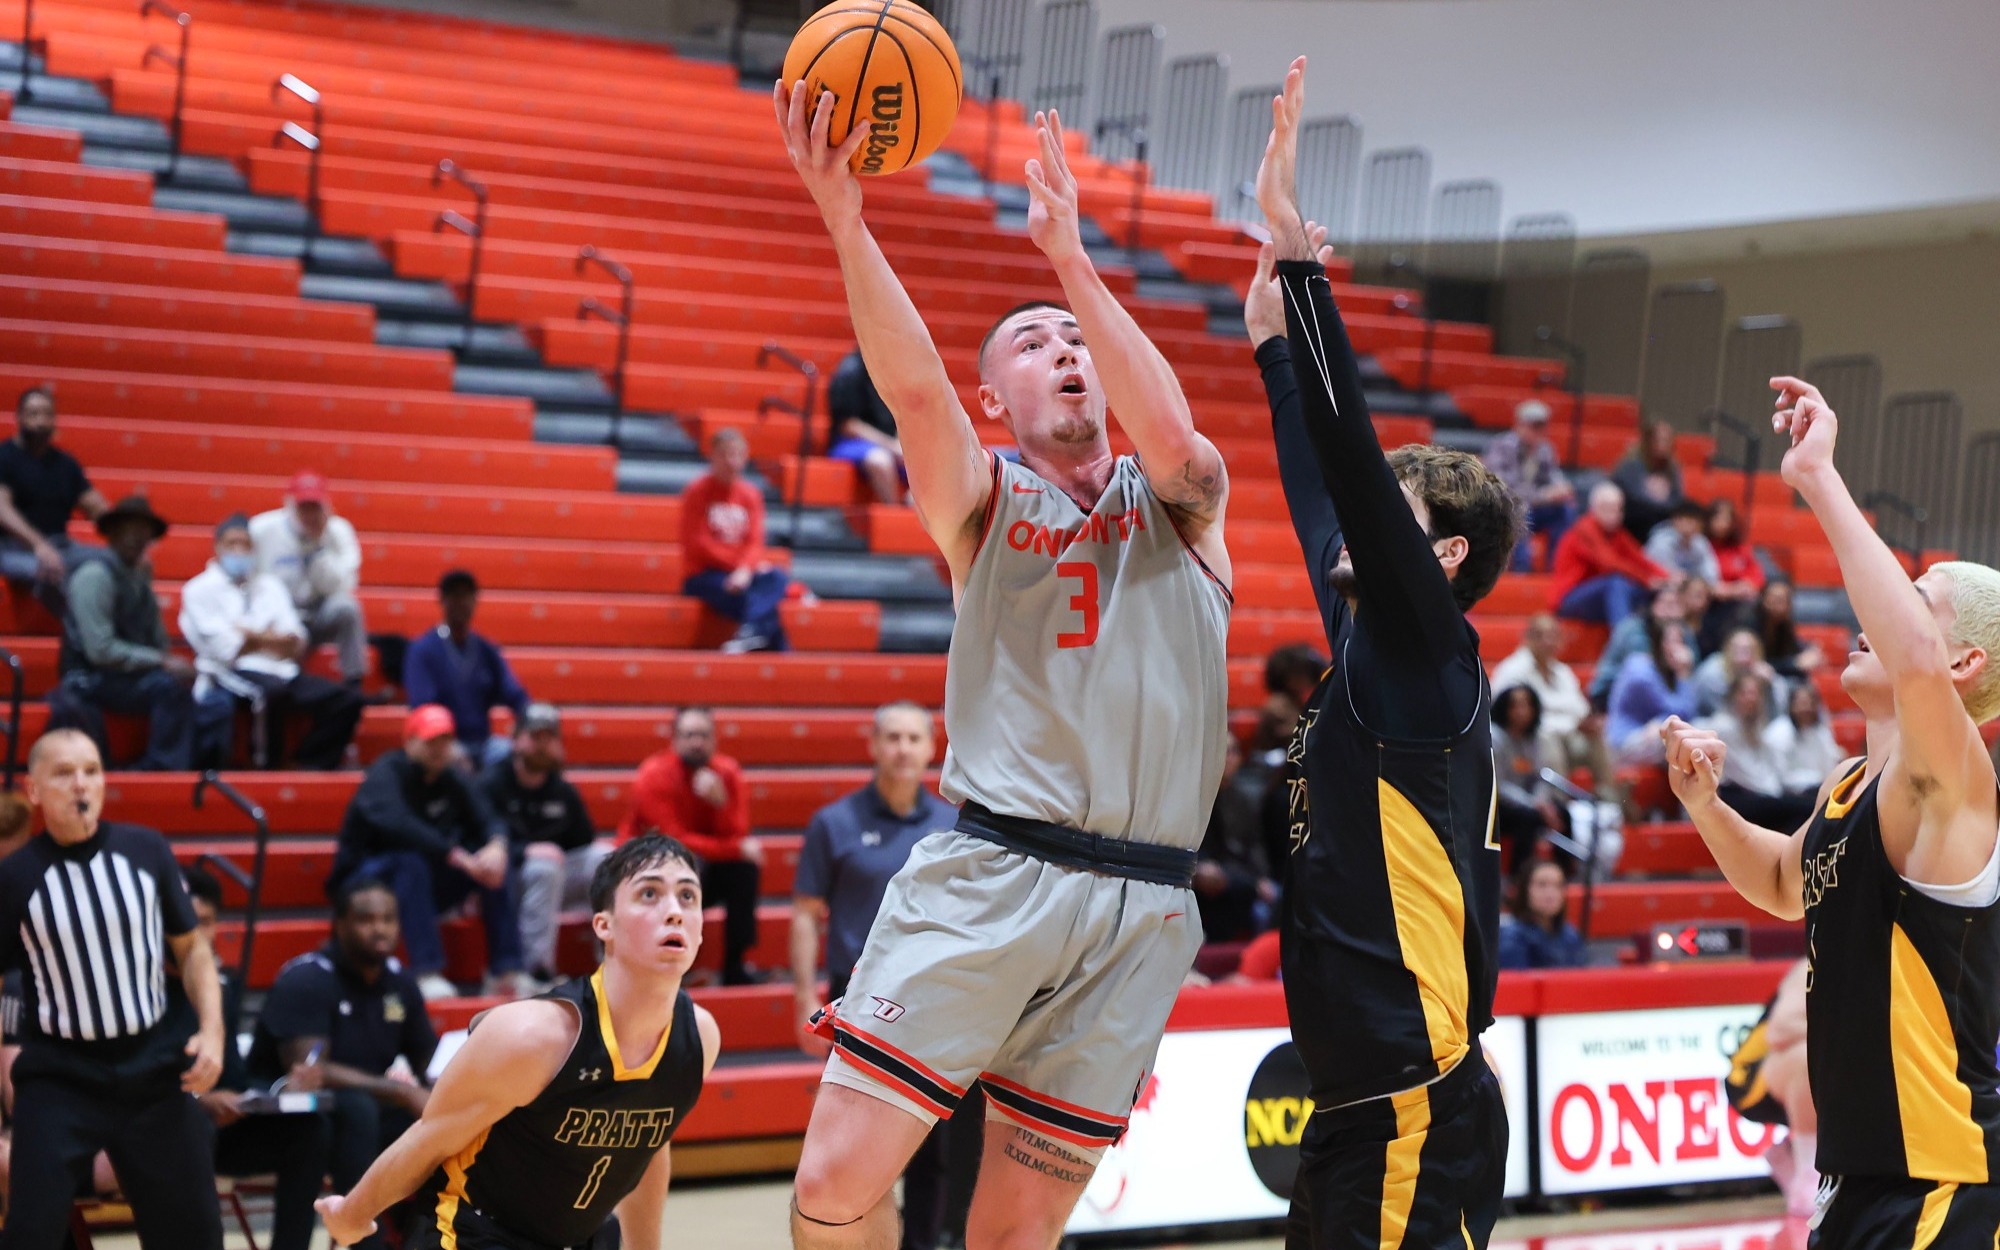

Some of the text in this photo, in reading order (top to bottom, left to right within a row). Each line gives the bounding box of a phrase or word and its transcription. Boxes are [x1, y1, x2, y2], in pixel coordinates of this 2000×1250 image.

[859, 82, 903, 174] Wilson
[1057, 562, 1099, 648] 3
[554, 1107, 674, 1148] PRATT
[573, 1155, 612, 1209] 1
